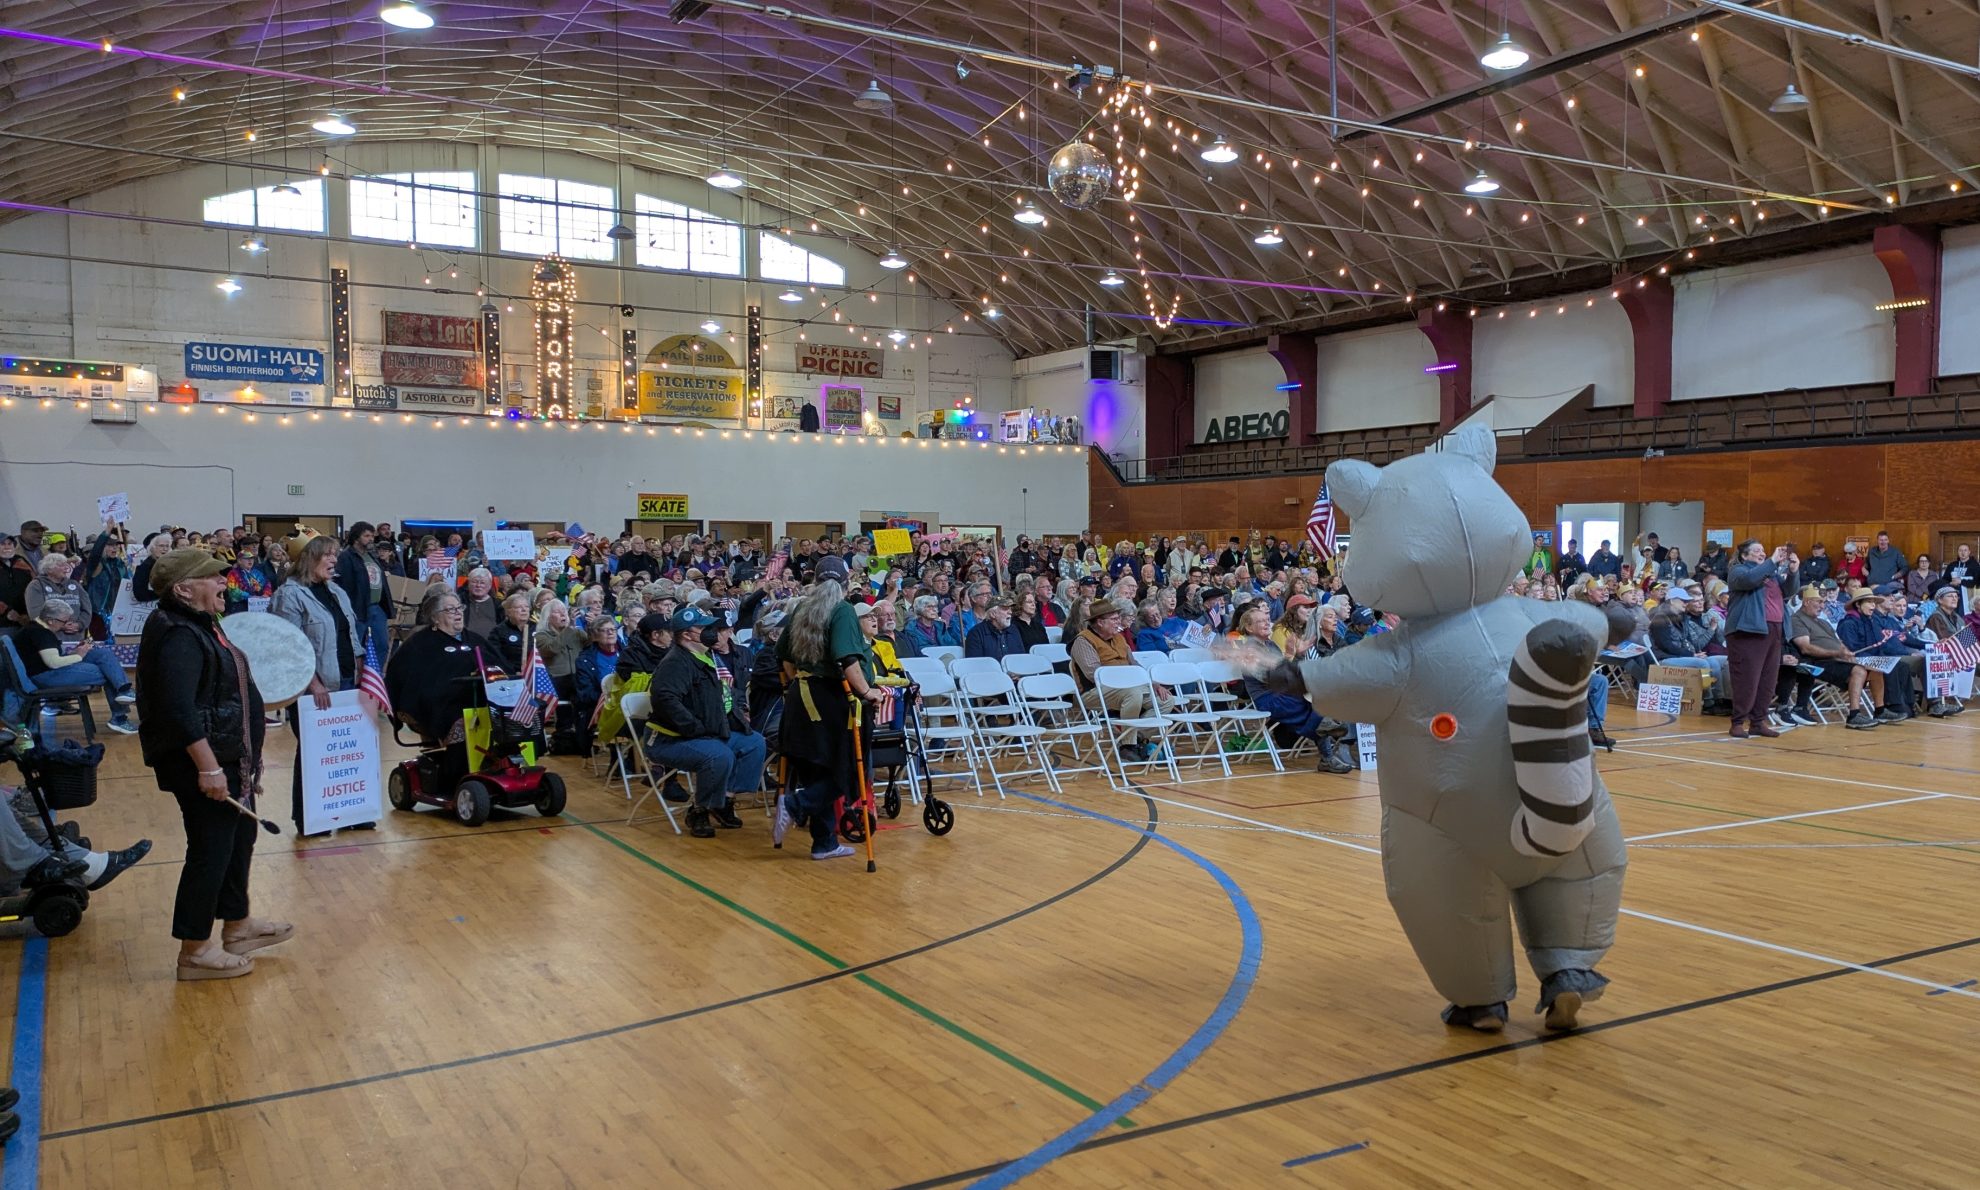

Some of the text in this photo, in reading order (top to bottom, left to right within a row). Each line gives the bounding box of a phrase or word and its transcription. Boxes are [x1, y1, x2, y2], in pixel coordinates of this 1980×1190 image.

[680, 340, 708, 352] AR
[191, 345, 320, 367] SUOMI-HALL
[661, 351, 725, 364] RAIL SHIP
[191, 363, 284, 377] FINNISH BROTHERHOOD
[802, 356, 879, 376] PICNIC
[653, 375, 728, 391] TICKETS
[405, 393, 448, 403] ASTORIA
[646, 390, 737, 402] and RESERVATIONS
[656, 400, 717, 413] Anywhere
[1204, 409, 1290, 444] ABECO
[290, 485, 304, 494] EXIT
[640, 500, 686, 513] SKATE
[1662, 667, 1688, 676] TRUMP
[1647, 684, 1660, 712] PRESS
[1660, 688, 1670, 711] FREE
[317, 713, 363, 727] DEMOCRACY
[331, 727, 351, 738] RULE
[1360, 731, 1376, 739] enem
[326, 740, 358, 752] OF LAW
[320, 751, 365, 766] FREE PRESS
[327, 766, 360, 779] LIBERTY
[321, 780, 366, 799] JUSTICE
[323, 797, 366, 812] FREE SPEECH
